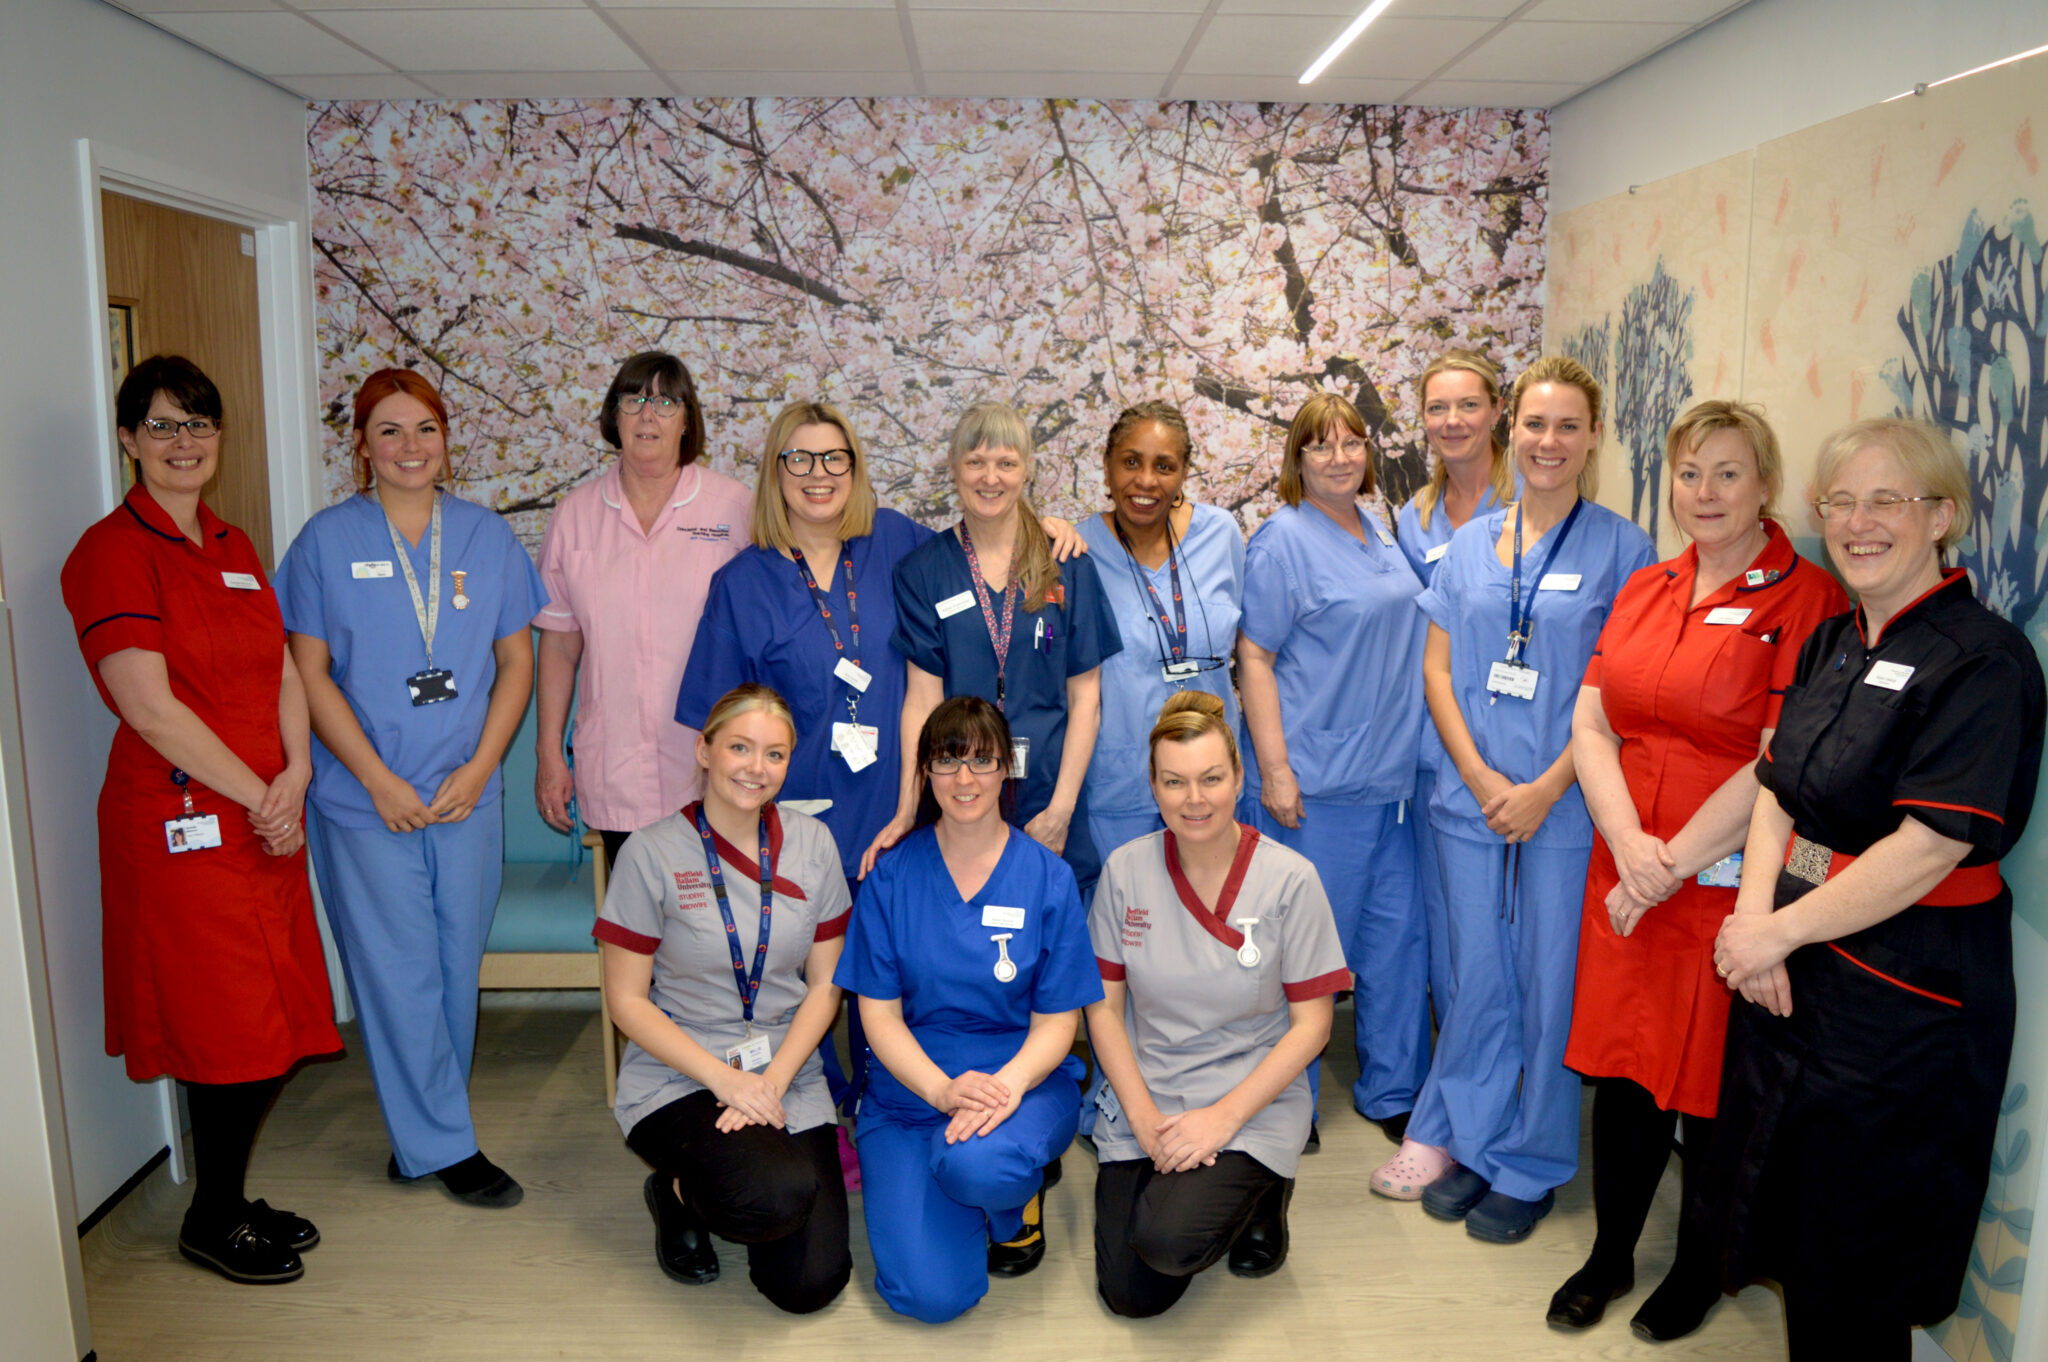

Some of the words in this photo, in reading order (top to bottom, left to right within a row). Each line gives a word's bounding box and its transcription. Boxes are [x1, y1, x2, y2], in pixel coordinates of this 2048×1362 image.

[677, 882, 712, 890] University
[678, 892, 705, 900] STUDENT
[679, 902, 707, 910] MIDWIFE
